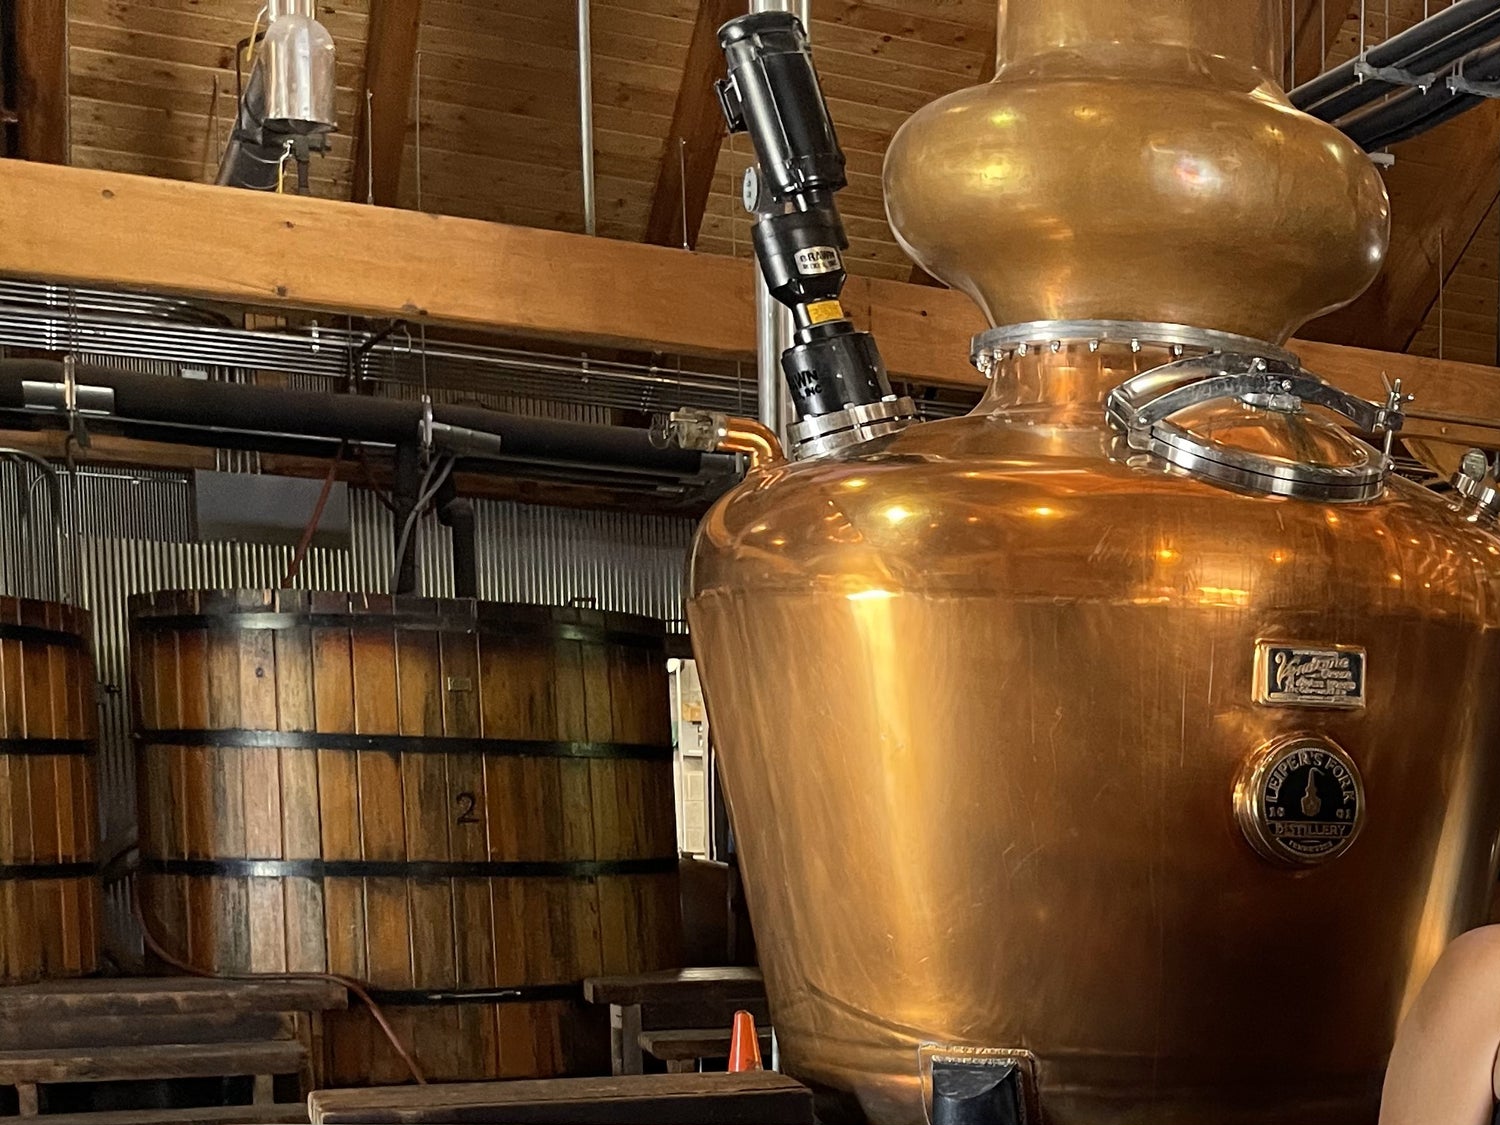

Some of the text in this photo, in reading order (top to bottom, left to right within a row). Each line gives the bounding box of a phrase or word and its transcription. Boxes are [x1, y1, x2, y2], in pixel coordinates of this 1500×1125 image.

[1266, 750, 1355, 804] LEIPER'S FORK
[456, 791, 480, 824] 2
[1275, 822, 1345, 835] DISTILLERY
